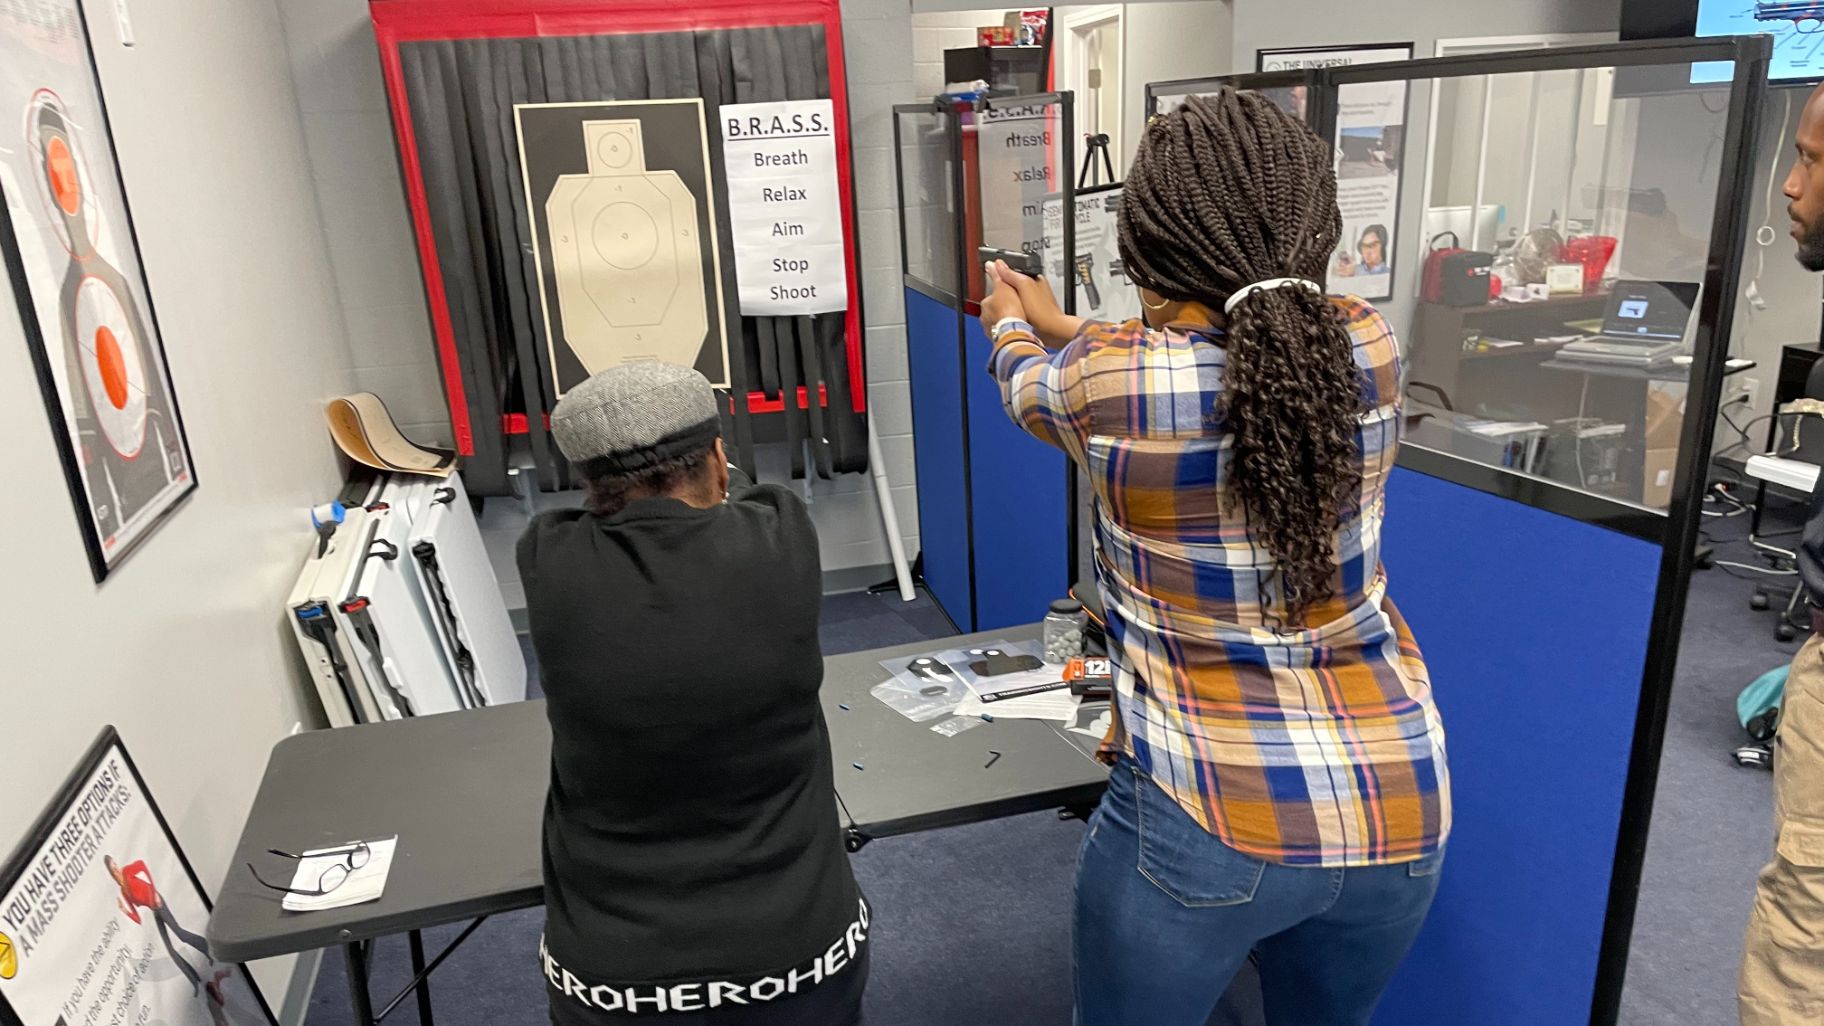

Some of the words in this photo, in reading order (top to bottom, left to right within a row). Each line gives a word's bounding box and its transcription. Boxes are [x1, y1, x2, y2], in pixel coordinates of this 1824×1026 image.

[728, 113, 828, 137] B.R.A.S.S.
[754, 149, 809, 167] Breath
[763, 186, 808, 203] Relax
[771, 222, 804, 237] Aim
[773, 258, 809, 275] Stop
[770, 285, 817, 301] Shoot
[3, 892, 32, 932] YOU
[24, 854, 57, 908] HAVE
[52, 815, 83, 866] THREE
[77, 770, 115, 826] OPTIONS
[109, 759, 122, 783] IF
[18, 934, 35, 959] A
[27, 889, 60, 944] MASS
[53, 834, 99, 903] SHOOTER
